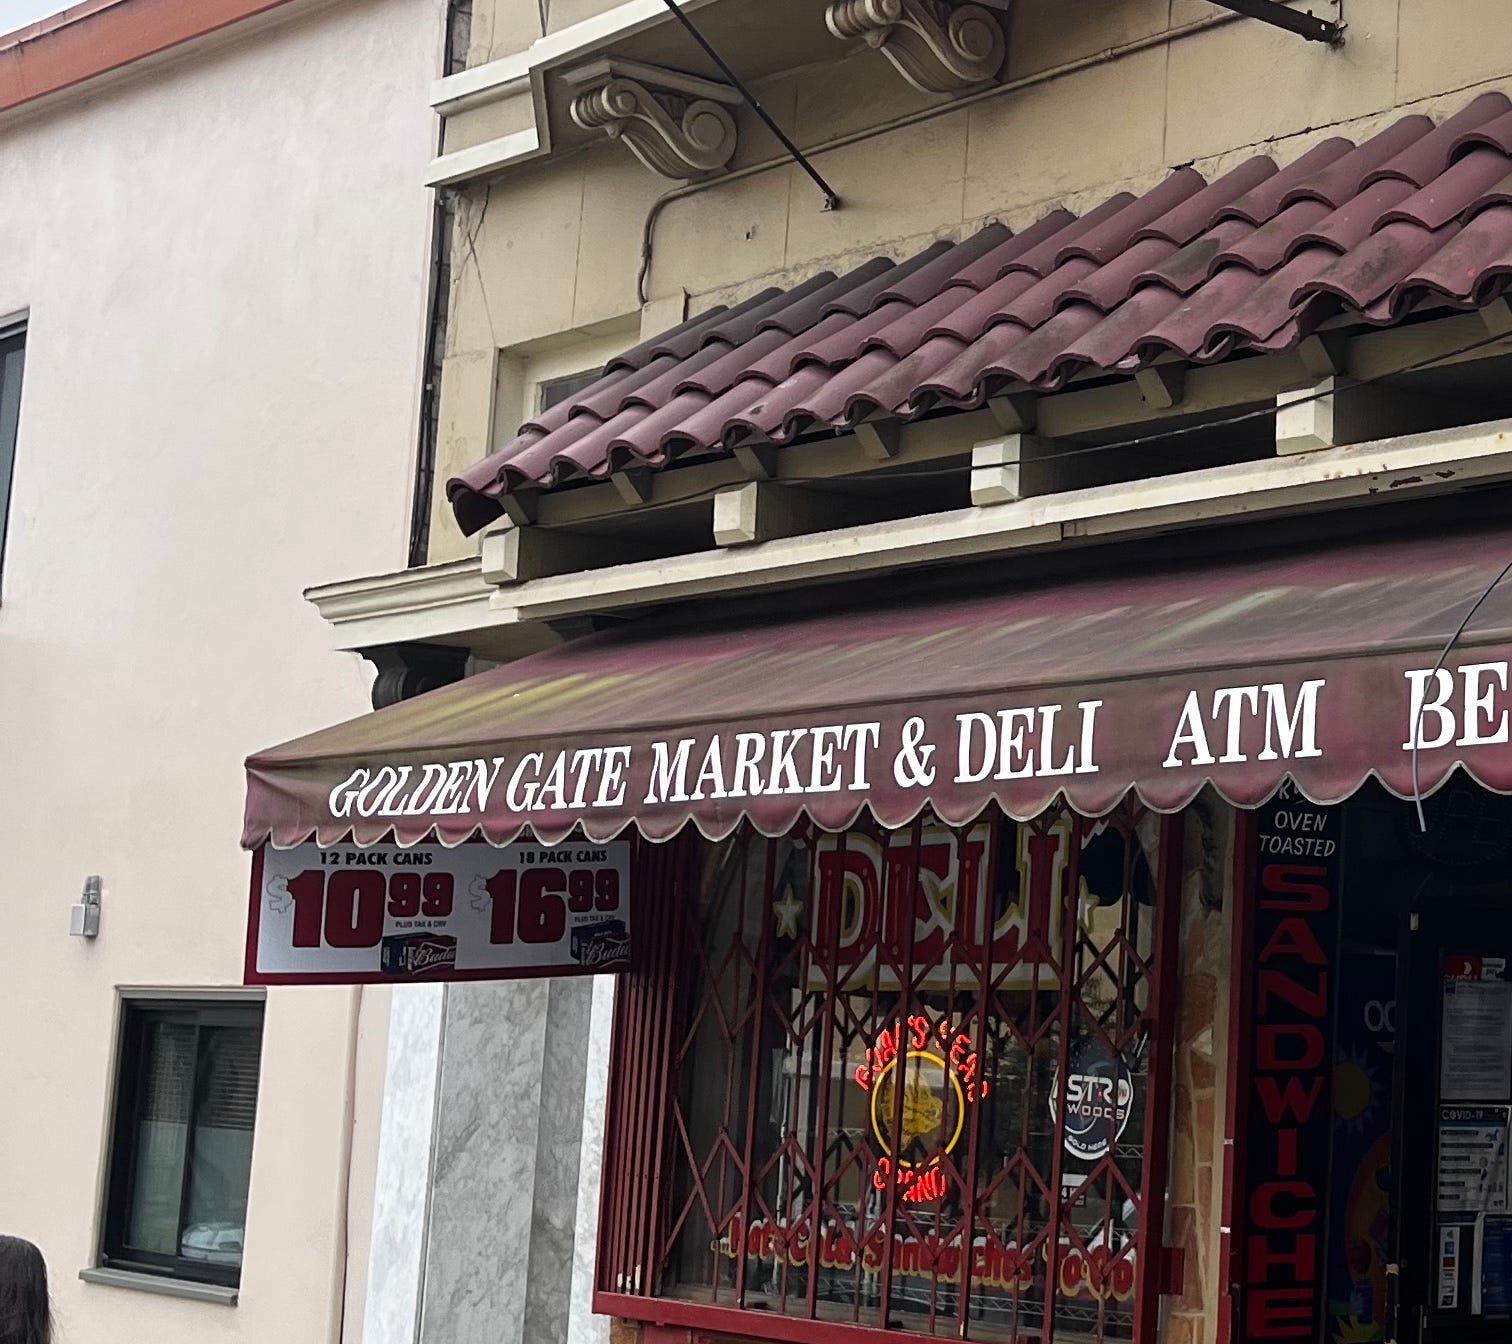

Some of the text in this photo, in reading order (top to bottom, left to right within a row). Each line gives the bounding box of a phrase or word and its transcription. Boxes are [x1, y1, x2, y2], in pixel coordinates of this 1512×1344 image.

[328, 757, 505, 818] GOLDEN
[505, 745, 632, 812] GATE
[643, 721, 881, 804] MARKET
[892, 715, 937, 788] &
[953, 699, 1103, 784] DELI
[1162, 678, 1326, 768] ATM
[1273, 810, 1328, 832] OVEN
[519, 849, 608, 864] 18 PACK CANS
[1258, 833, 1337, 858] TOASTED
[319, 851, 434, 865] 12 PACK CANS
[810, 819, 1068, 986] DELI
